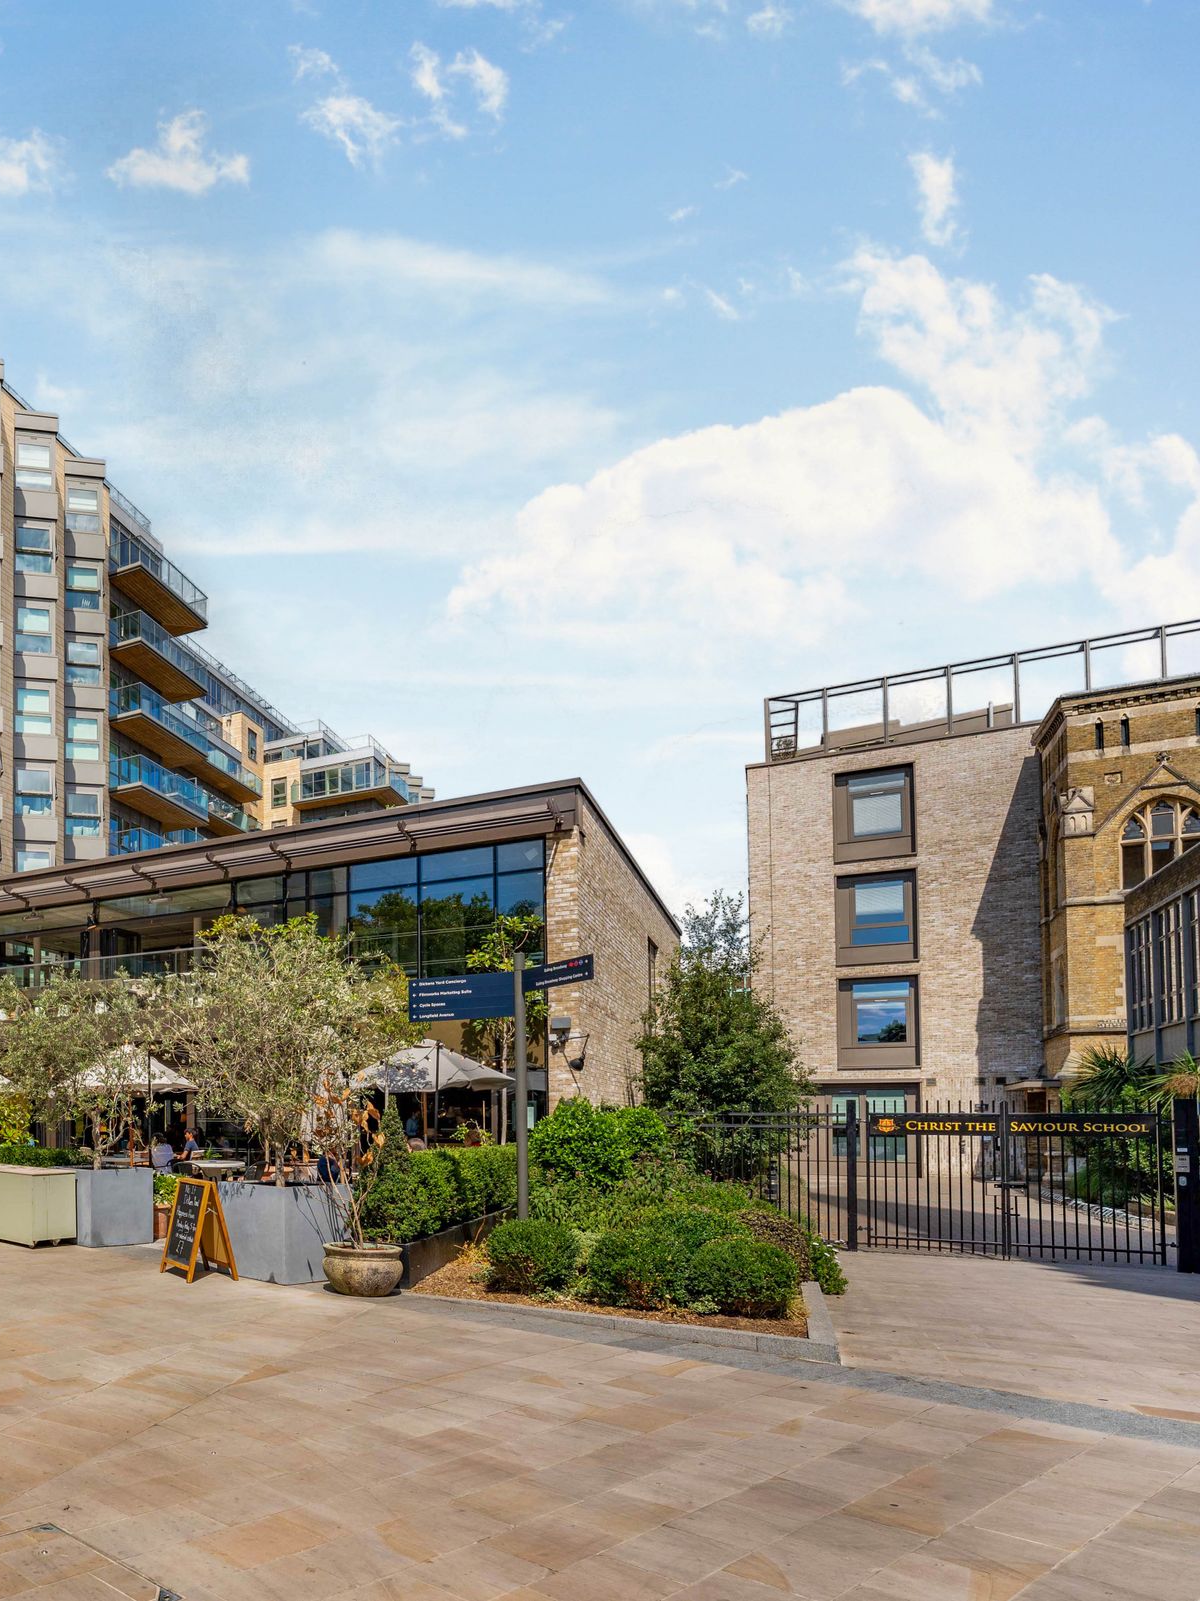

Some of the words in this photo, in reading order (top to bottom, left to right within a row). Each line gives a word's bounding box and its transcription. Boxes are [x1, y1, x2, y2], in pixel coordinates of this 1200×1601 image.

[905, 1120, 962, 1131] CHRIST
[964, 1122, 996, 1132] THE
[1010, 1121, 1080, 1132] SAVIOUR
[1082, 1122, 1149, 1133] SCHOOL
